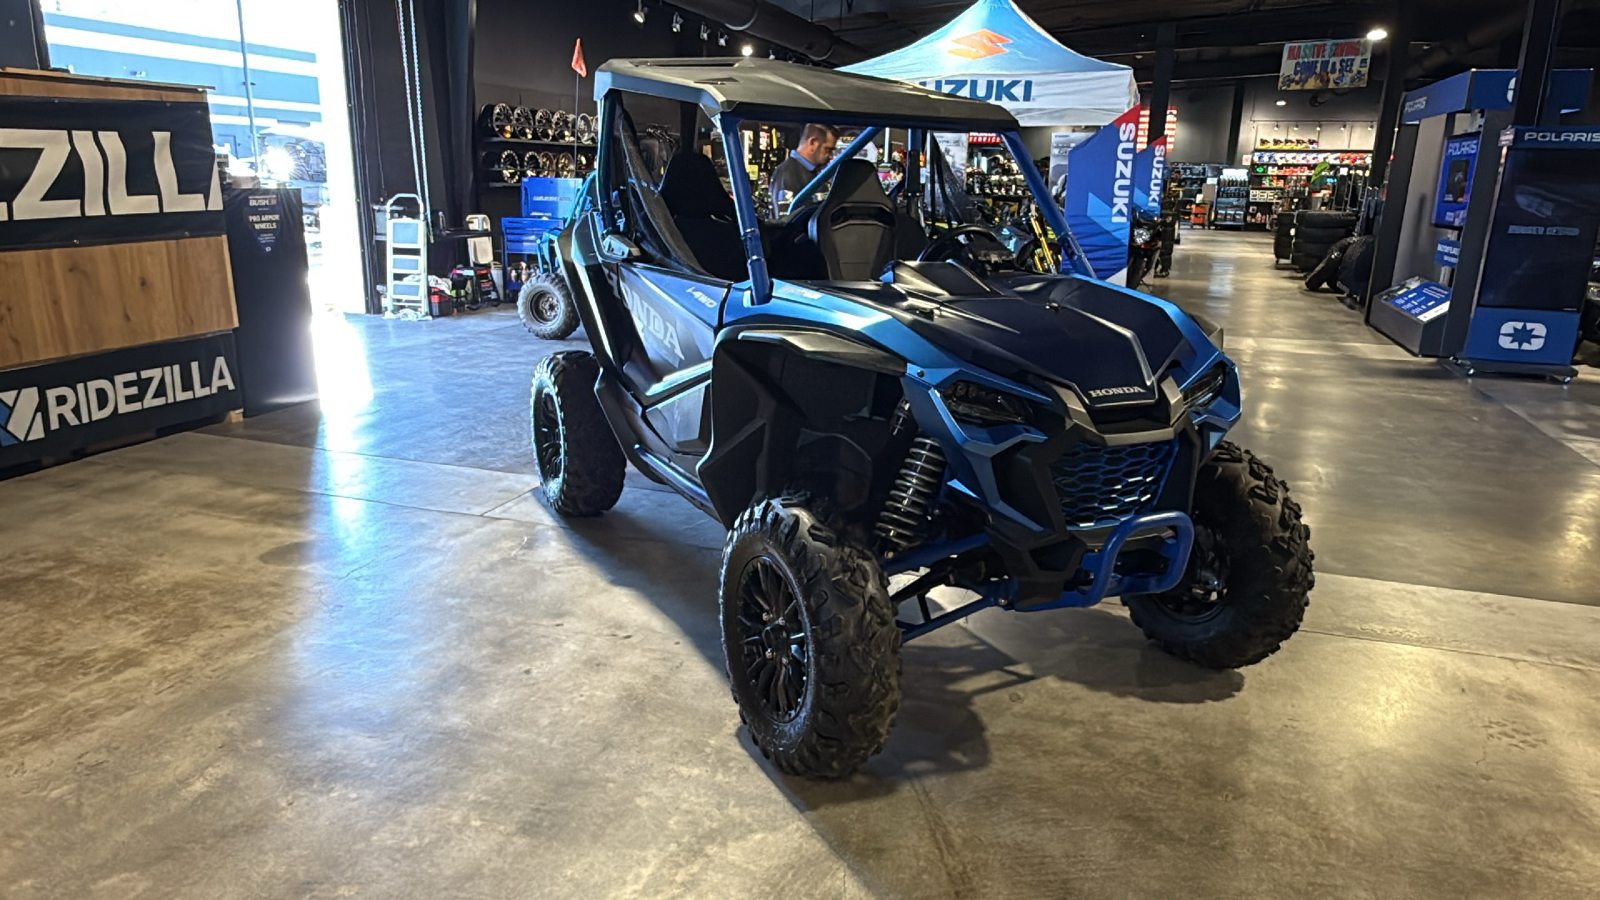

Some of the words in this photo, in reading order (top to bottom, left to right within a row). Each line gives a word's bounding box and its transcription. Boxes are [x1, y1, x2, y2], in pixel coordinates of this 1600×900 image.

[1293, 60, 1317, 75] COME
[968, 135, 1002, 143] SERVICE
[1524, 131, 1600, 142] POLARIS
[1447, 140, 1478, 156] POLARIS
[0, 127, 224, 221] ZILL
[1111, 122, 1136, 223] SUZUKI
[1147, 144, 1166, 207] SUZUKI
[254, 222, 277, 230] WHEELS
[45, 355, 236, 431] RIDEZILLA
[1088, 386, 1147, 398] HONDA
